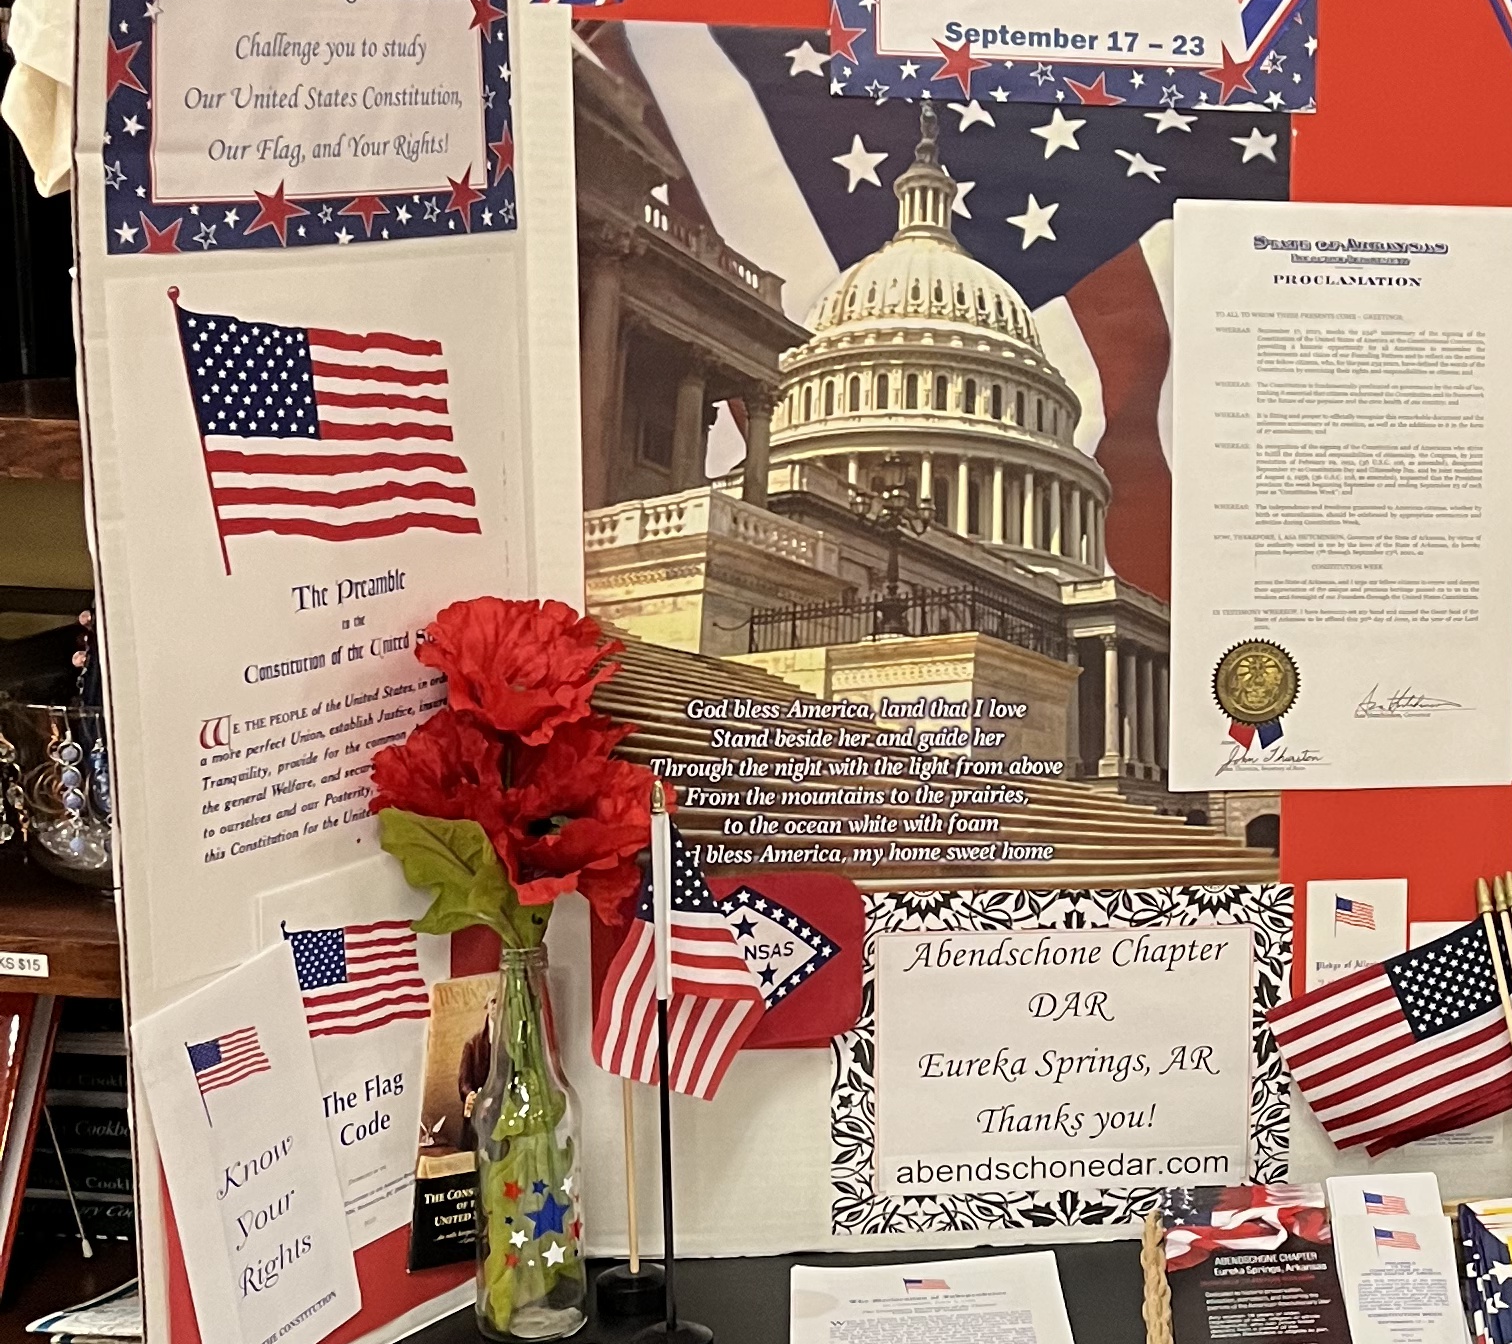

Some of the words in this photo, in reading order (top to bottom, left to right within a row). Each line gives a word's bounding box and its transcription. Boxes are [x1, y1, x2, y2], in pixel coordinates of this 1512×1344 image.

[235, 32, 321, 65] Challenge
[325, 40, 356, 65] you
[360, 39, 378, 58] to
[383, 33, 427, 65] study
[944, 22, 1098, 51] September
[1107, 31, 1138, 53] 17
[1172, 35, 1205, 56] 23
[184, 87, 226, 110] Our
[231, 83, 303, 110] United
[306, 86, 358, 109] States
[362, 83, 463, 110] Constitution,
[208, 138, 251, 161] Our
[256, 135, 306, 167] Flag,
[312, 134, 342, 159] and
[348, 135, 390, 157] Your
[393, 132, 450, 162] Rights!
[1273, 274, 1422, 287] PROCLAMATION
[291, 584, 328, 614] The
[336, 568, 406, 605] Preamble
[244, 653, 326, 684] Constitution
[331, 646, 344, 666] of
[348, 644, 364, 661] the
[370, 631, 409, 659] United
[245, 717, 267, 734] THE
[269, 708, 308, 728] PEOPLE
[311, 703, 323, 716] of
[325, 698, 341, 713] the
[345, 688, 379, 708] United
[382, 682, 416, 701] States,
[687, 699, 728, 719] God
[733, 699, 780, 719] bless
[787, 700, 876, 720] America,
[881, 698, 925, 718] land
[930, 698, 968, 718] that
[973, 700, 983, 718] I
[989, 699, 1027, 718] love
[711, 729, 769, 748] Stand
[775, 728, 833, 747] beside
[838, 728, 871, 747] her
[876, 728, 913, 747] and
[917, 729, 969, 752] guide
[973, 728, 1005, 747] her
[650, 758, 733, 782] Through
[739, 758, 769, 776] the
[774, 757, 822, 782] night
[828, 757, 868, 776] with
[874, 757, 903, 775] the
[909, 757, 950, 780] light
[954, 757, 1002, 778] from
[1009, 756, 1064, 775] above
[685, 787, 740, 806] From
[746, 787, 775, 805] the
[781, 786, 885, 805] mountains
[890, 788, 909, 805] to
[915, 785, 944, 804] the
[950, 785, 1029, 808] prairies,
[723, 817, 744, 834] to
[749, 815, 780, 834] the
[784, 818, 842, 834] ocean
[849, 814, 898, 833] white
[903, 813, 943, 832] with
[948, 812, 999, 835] foam
[706, 845, 753, 863] bless
[759, 844, 848, 864] America,
[852, 846, 885, 866] my
[889, 843, 942, 861] home
[946, 844, 996, 860] sweet
[1001, 841, 1054, 860] home
[19, 958, 40, 972] $15
[744, 941, 794, 960] NSAS
[902, 936, 1102, 973] Abendschone
[1111, 933, 1229, 972] Chapter
[1027, 990, 1116, 1022] DAR
[918, 1046, 1027, 1082] Eureka
[1035, 1047, 1151, 1083] Springs,
[1159, 1044, 1221, 1076] AR
[321, 1087, 359, 1120] The
[363, 1070, 405, 1111] Flag
[339, 1110, 392, 1149] Code
[976, 1102, 1085, 1138] Thanks
[1088, 1103, 1157, 1139] you!
[216, 1134, 294, 1201] Know
[896, 1152, 1229, 1185] abendschonedar.com
[237, 1233, 314, 1299] Rights
